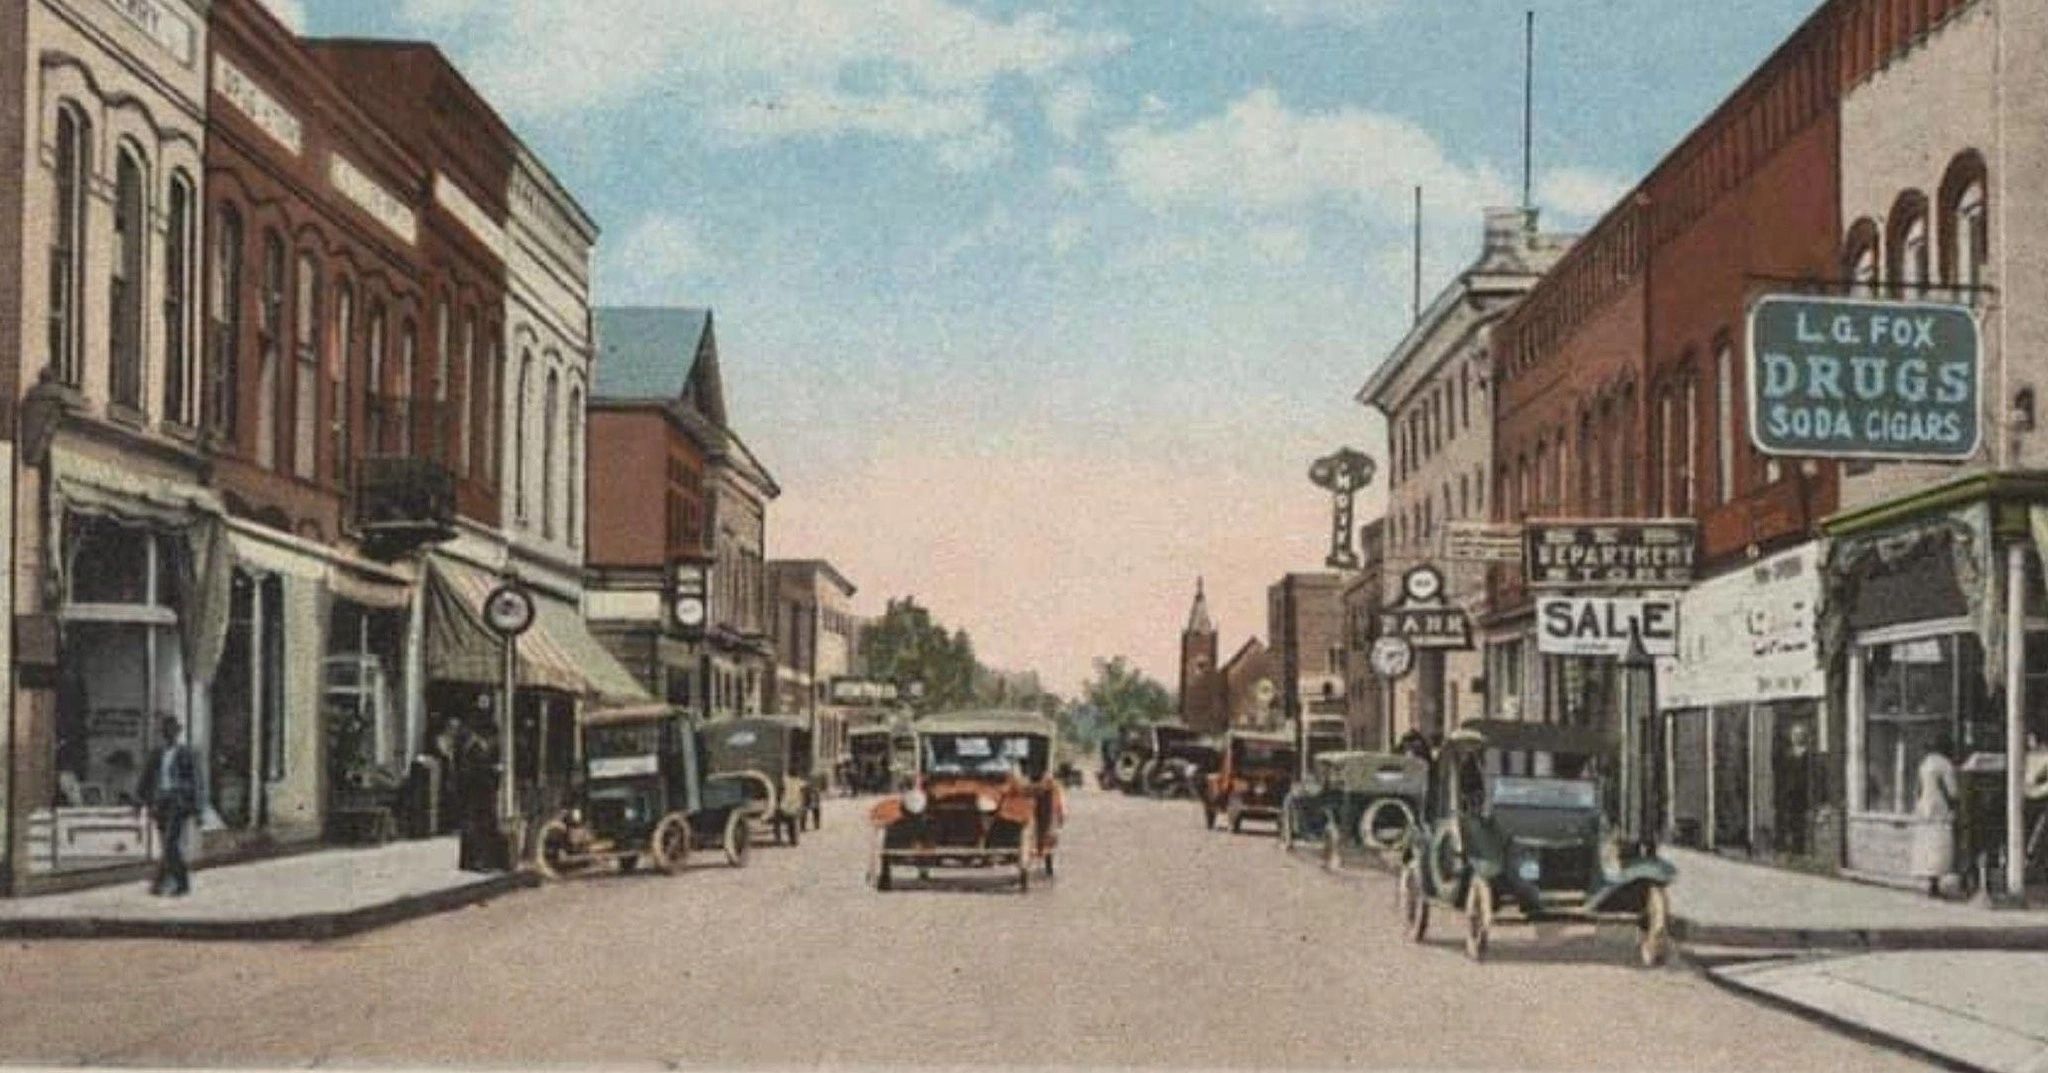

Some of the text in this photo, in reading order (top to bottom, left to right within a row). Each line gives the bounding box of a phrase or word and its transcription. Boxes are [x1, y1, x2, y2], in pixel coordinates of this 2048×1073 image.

[1870, 315, 1936, 348] FOX
[1763, 353, 1969, 402] DRUGS
[1768, 404, 1961, 442] SODA CIGARS
[1538, 545, 1694, 565] DEPARTMENT
[1545, 601, 1673, 639] SALE
